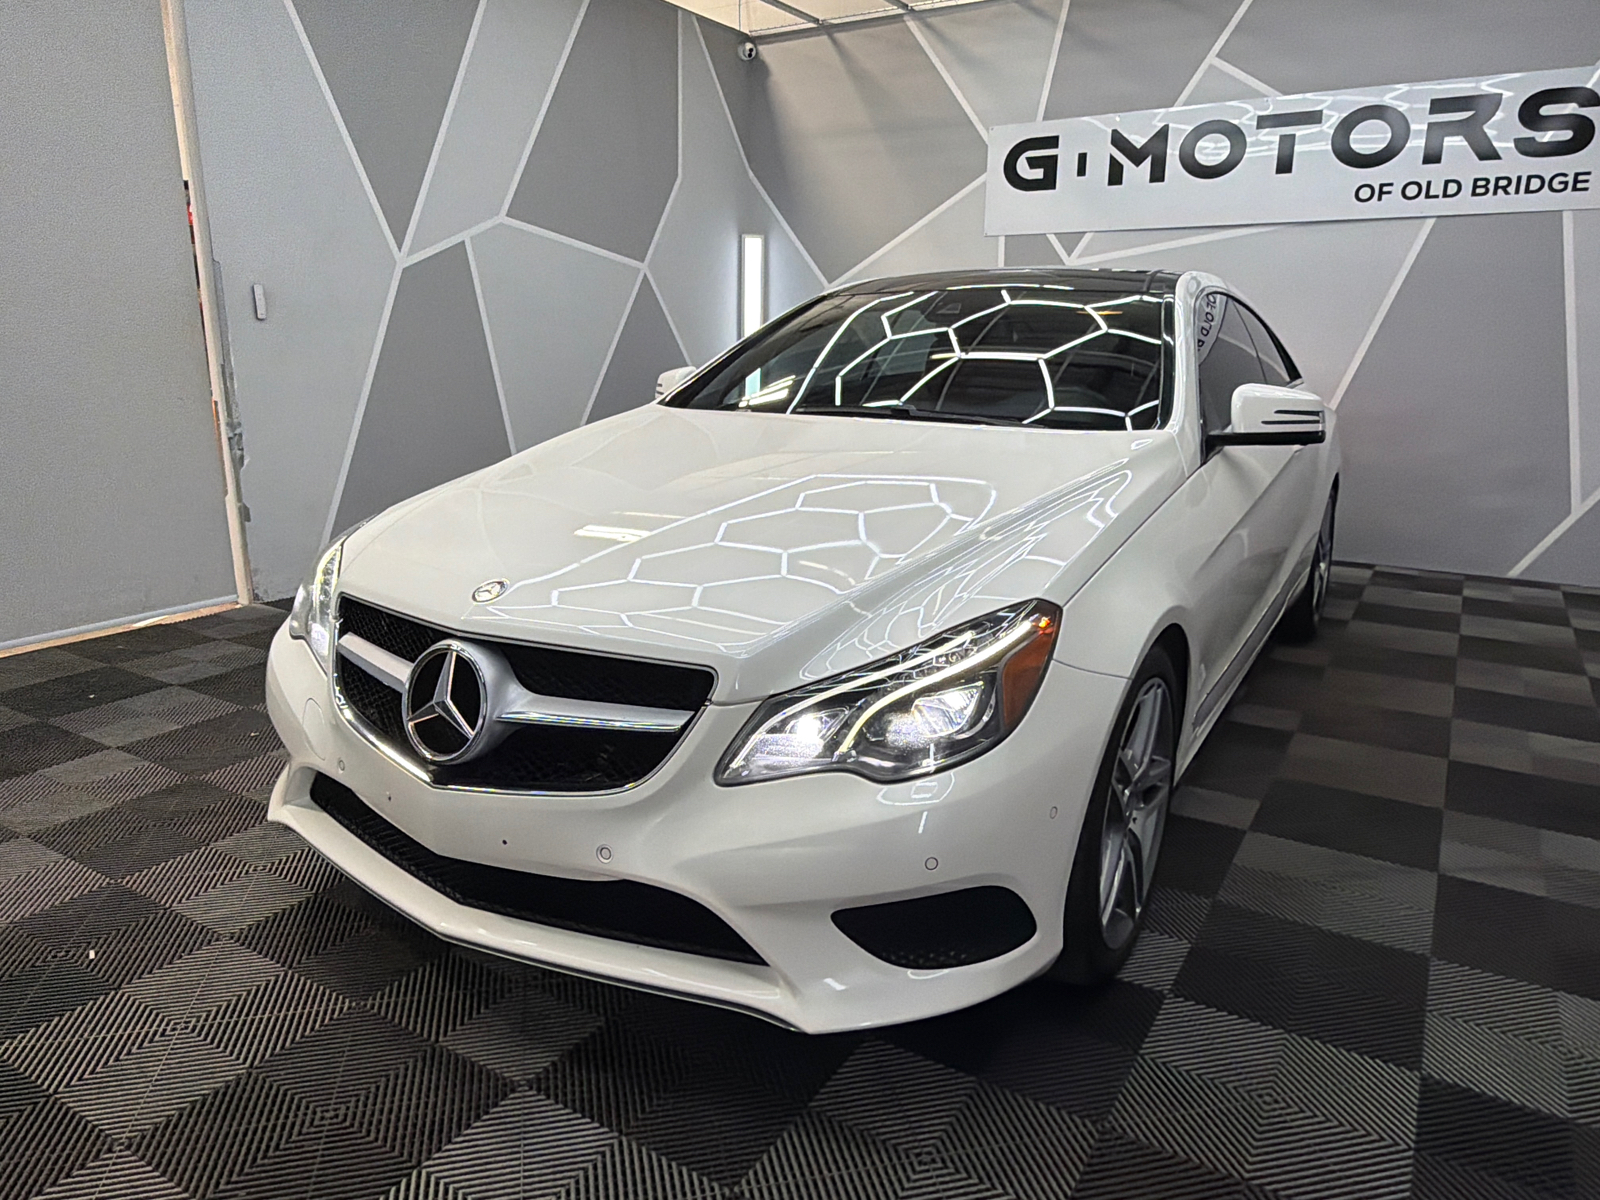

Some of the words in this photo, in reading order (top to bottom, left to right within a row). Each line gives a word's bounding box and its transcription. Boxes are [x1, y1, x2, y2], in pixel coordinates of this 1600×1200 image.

[1354, 182, 1394, 203] OF
[1400, 178, 1463, 201] OLD
[1470, 171, 1593, 199] BRIDGE
